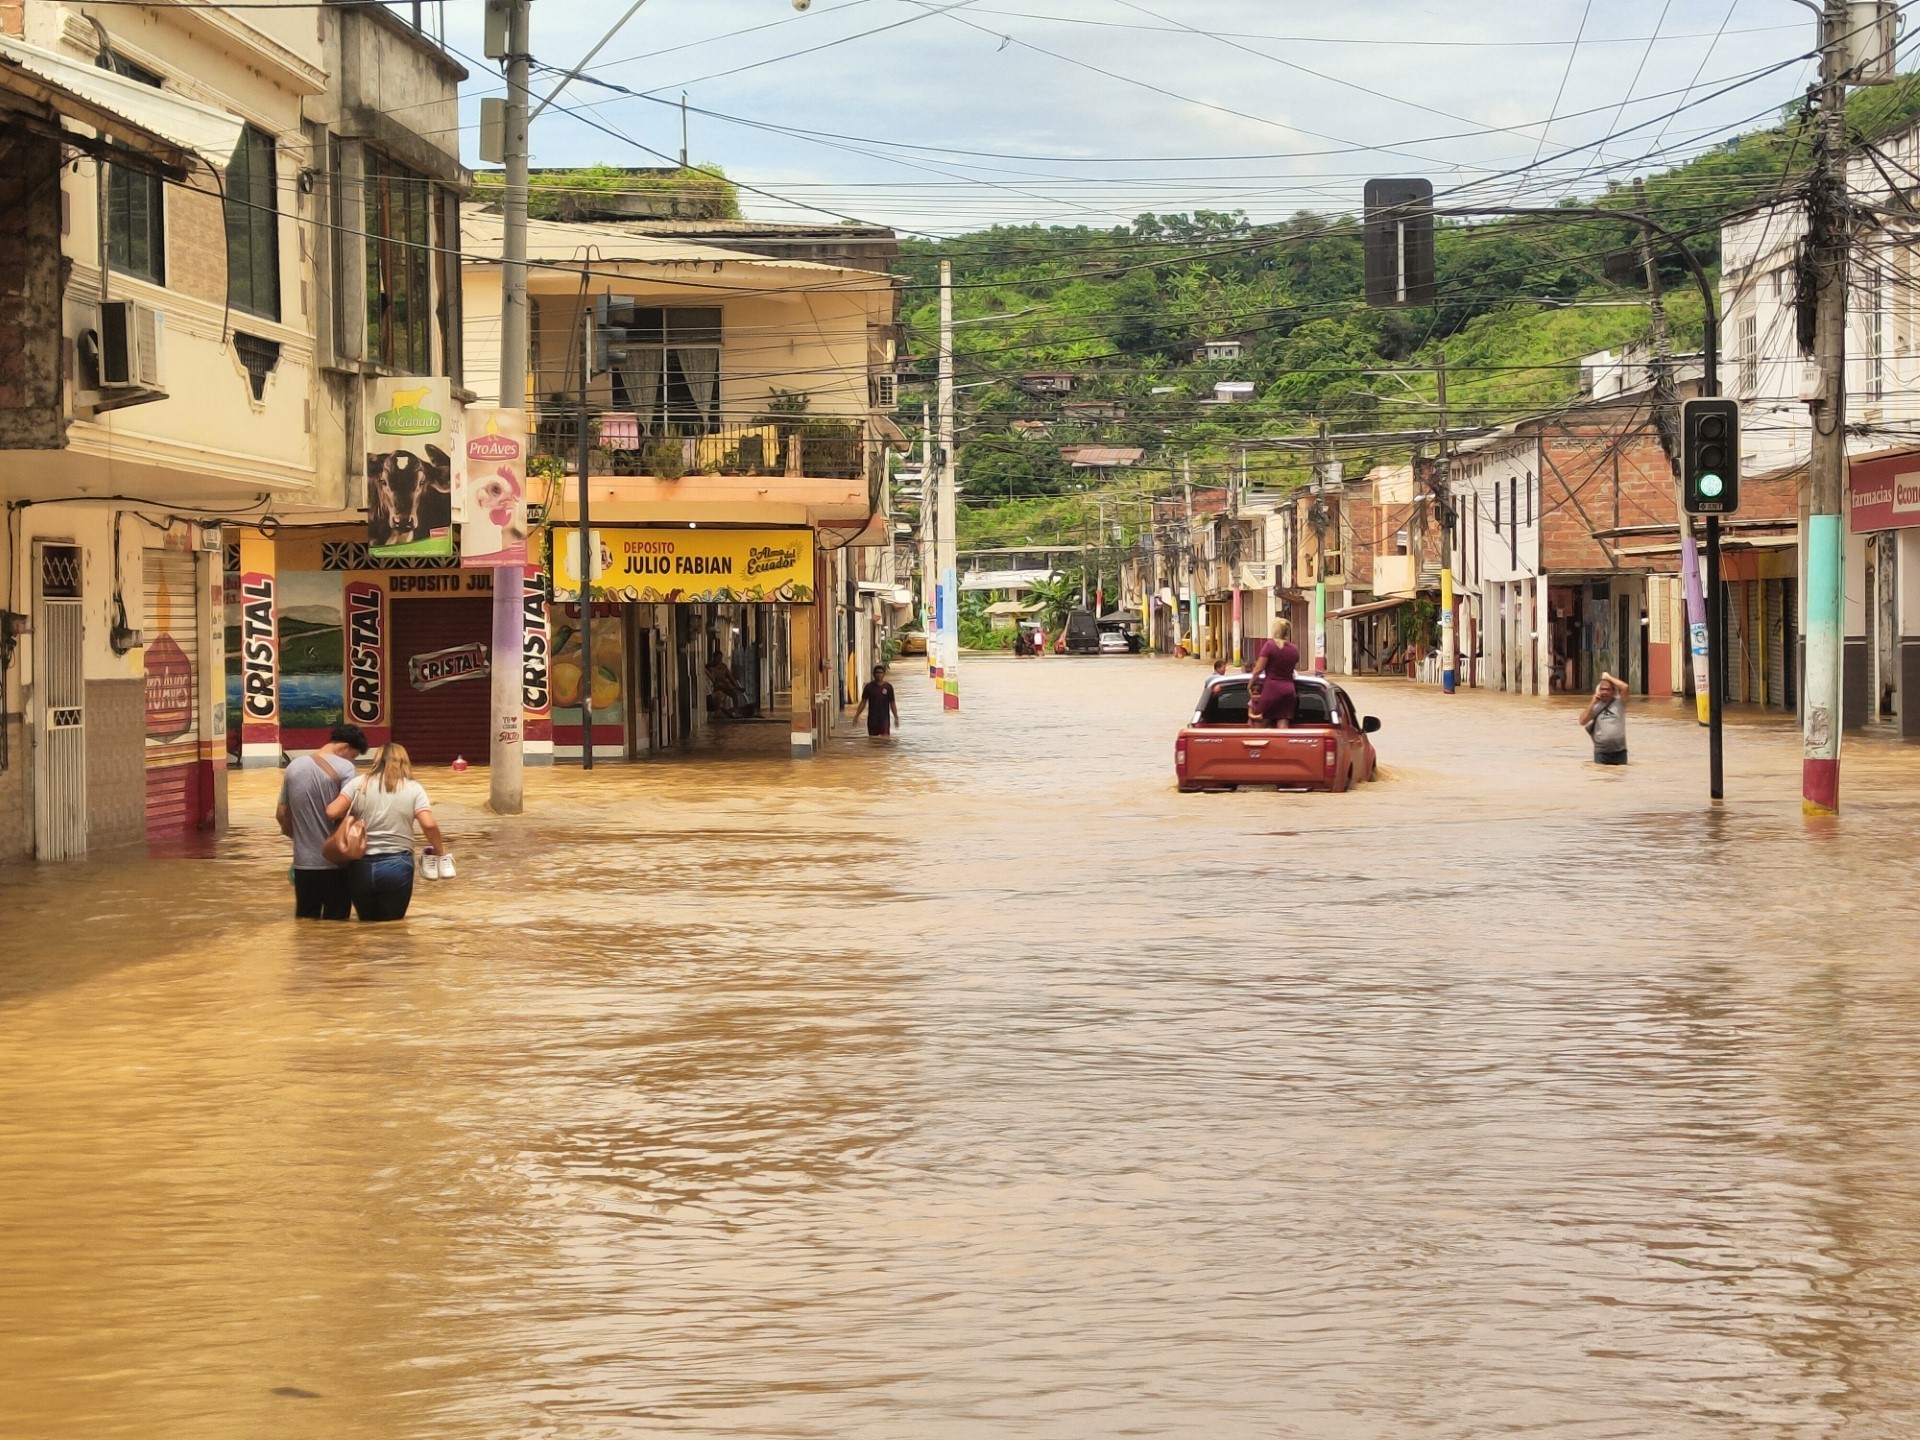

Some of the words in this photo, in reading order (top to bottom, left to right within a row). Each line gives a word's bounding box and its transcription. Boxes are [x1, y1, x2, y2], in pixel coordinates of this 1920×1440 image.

[1852, 485, 1893, 508] farmacias
[1897, 484, 1920, 505] econ
[623, 541, 675, 554] DEPOSITO
[756, 546, 785, 560] Alma
[784, 549, 796, 559] del
[623, 556, 671, 574] JULIO
[676, 556, 732, 574] FABIAN
[747, 556, 797, 576] Ecuador
[389, 575, 460, 592] DEPOSITO
[244, 580, 274, 717] CRISTAL
[522, 574, 548, 708] CRISTAL
[352, 590, 380, 721] CRISTAL
[420, 653, 480, 680] CRISTAL
